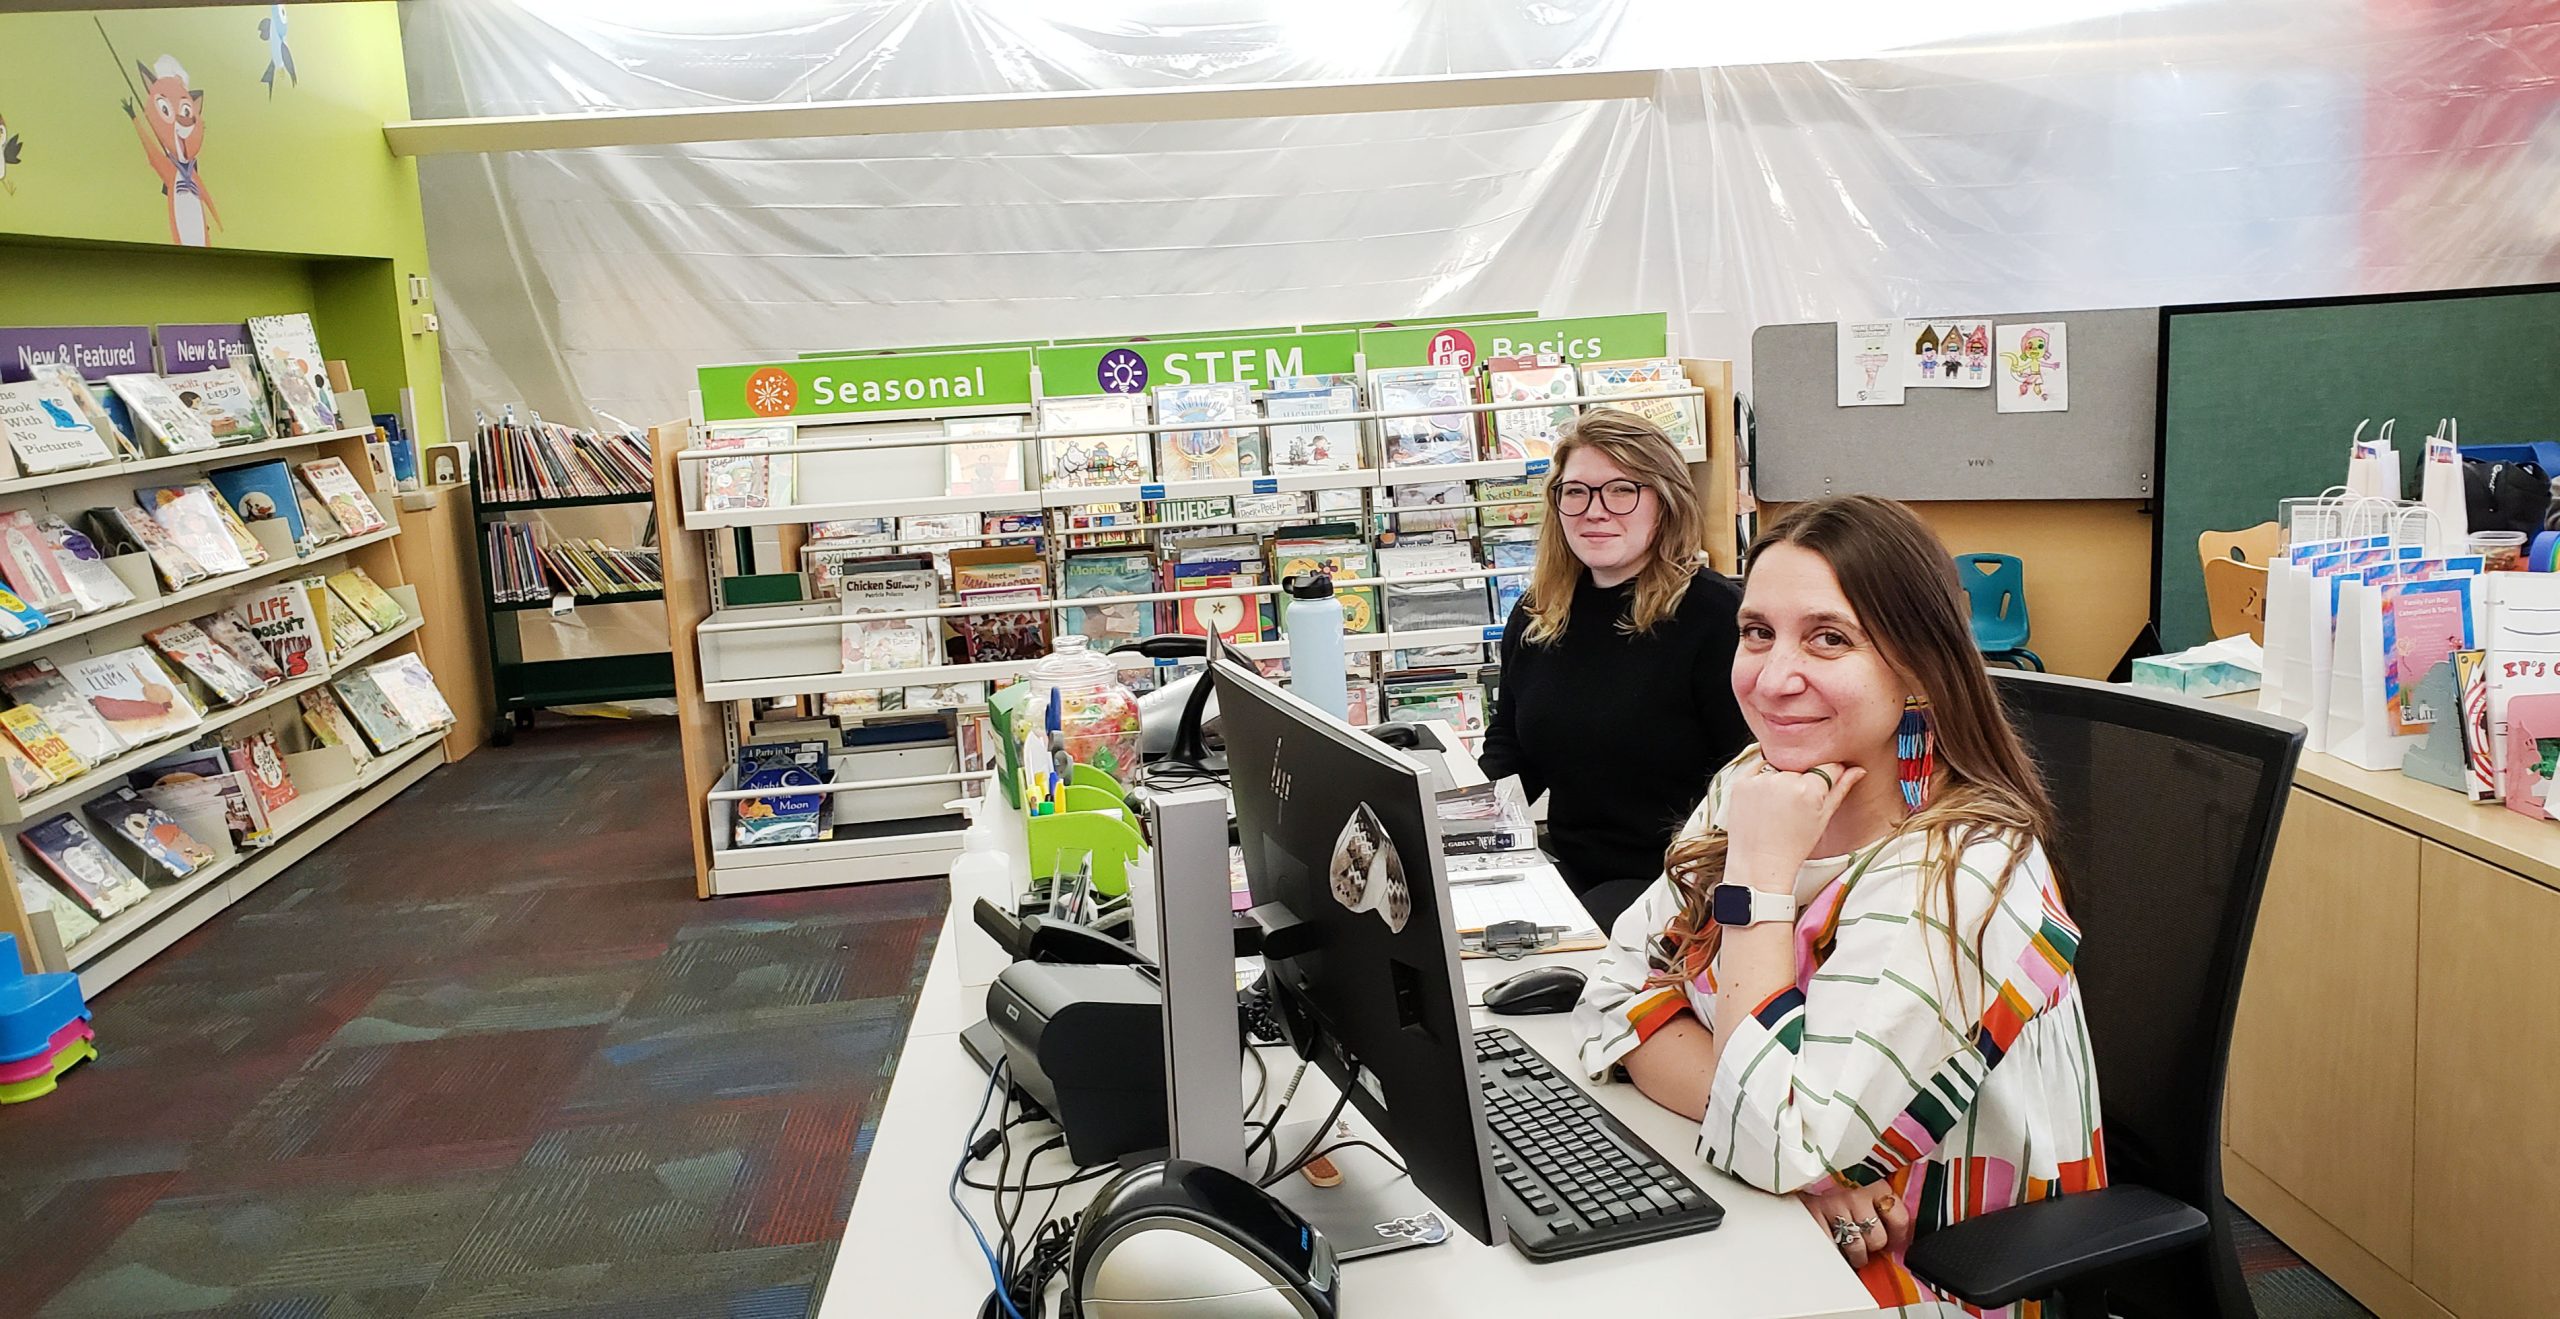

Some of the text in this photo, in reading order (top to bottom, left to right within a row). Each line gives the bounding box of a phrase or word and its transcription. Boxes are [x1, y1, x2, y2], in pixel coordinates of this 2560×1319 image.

[177, 339, 205, 362] New
[207, 338, 217, 361] &
[1493, 331, 1602, 359] Basics
[18, 341, 136, 370] New & Featured
[1164, 347, 1303, 388] STEM
[813, 366, 985, 406] Seasonal
[5, 415, 43, 428] With
[14, 430, 37, 442] No
[23, 439, 84, 455] Pictures
[1070, 564, 1116, 576] Monkey
[846, 580, 884, 592] Chicken
[2404, 597, 2424, 606] Family
[246, 596, 294, 626] LIFE
[252, 617, 305, 641] DOESN'T
[2503, 660, 2546, 678] IT'S
[780, 800, 809, 811] Moon
